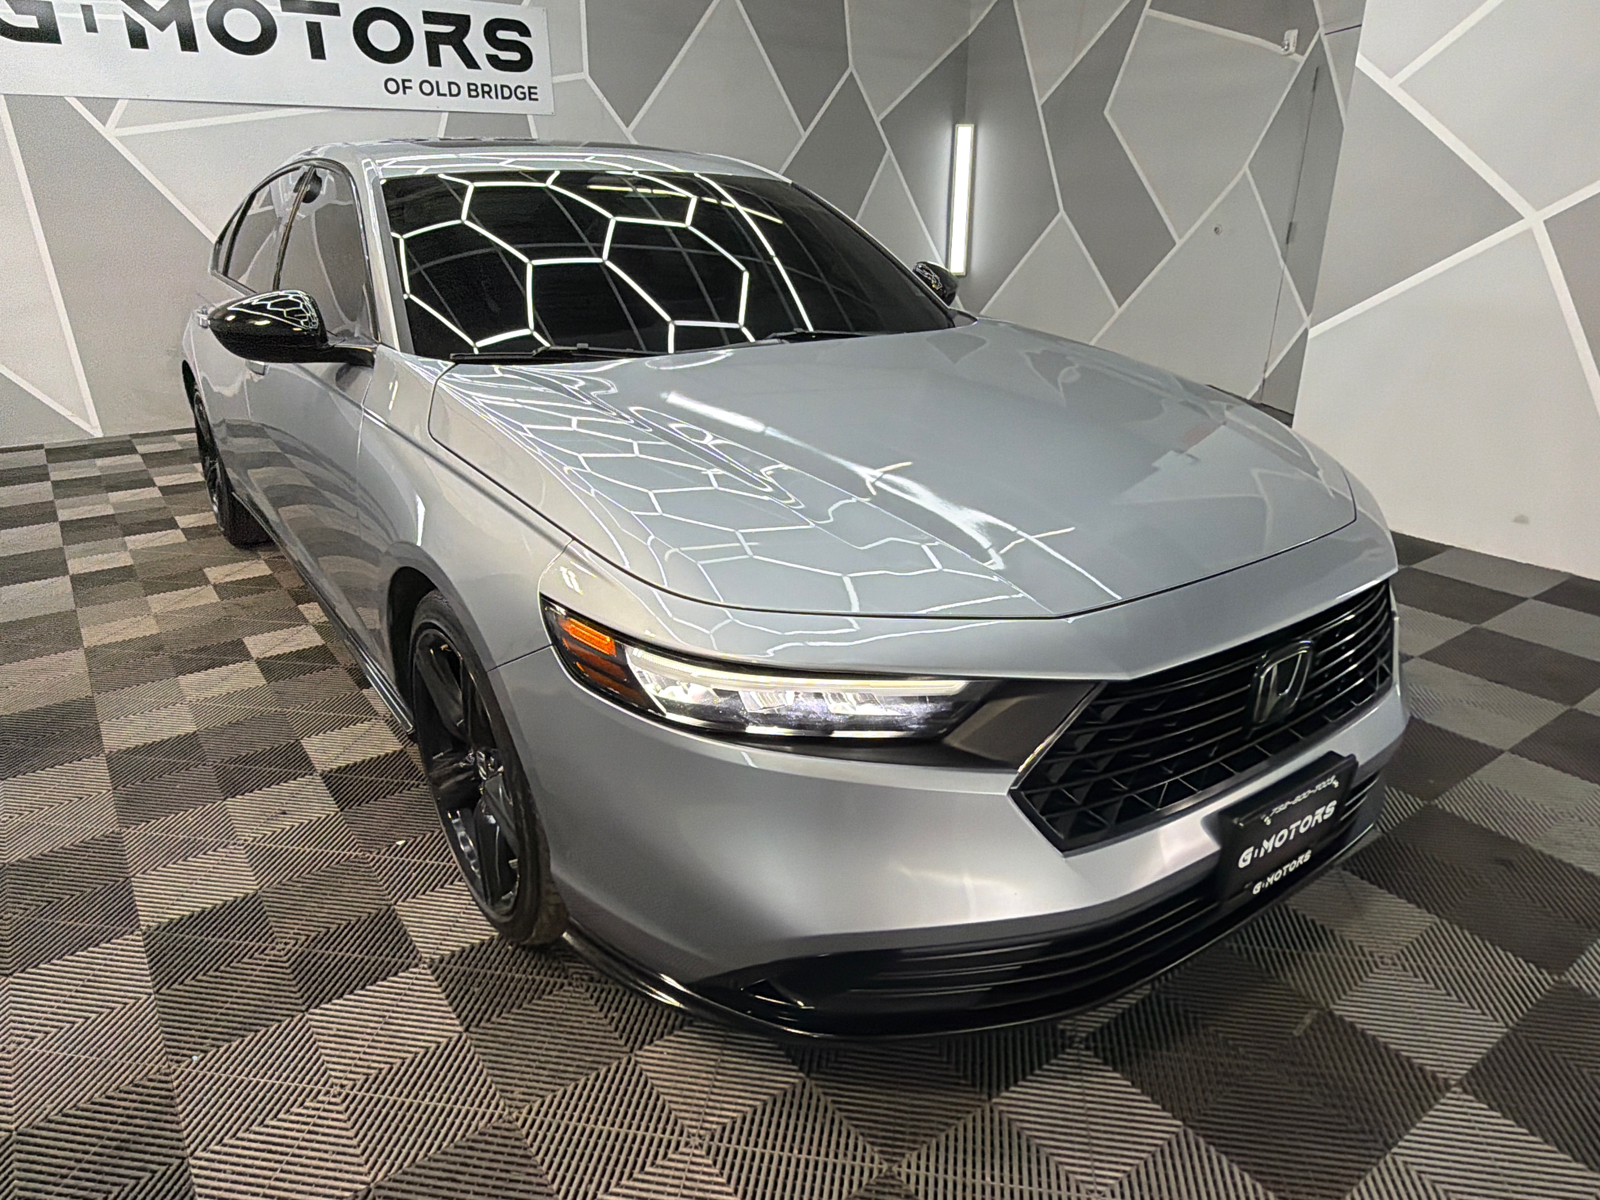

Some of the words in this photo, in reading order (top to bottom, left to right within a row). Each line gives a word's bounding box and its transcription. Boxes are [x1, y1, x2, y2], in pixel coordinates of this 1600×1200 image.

[384, 77, 413, 95] OF
[419, 79, 461, 98] OLD
[467, 82, 539, 101] BRIDGE
